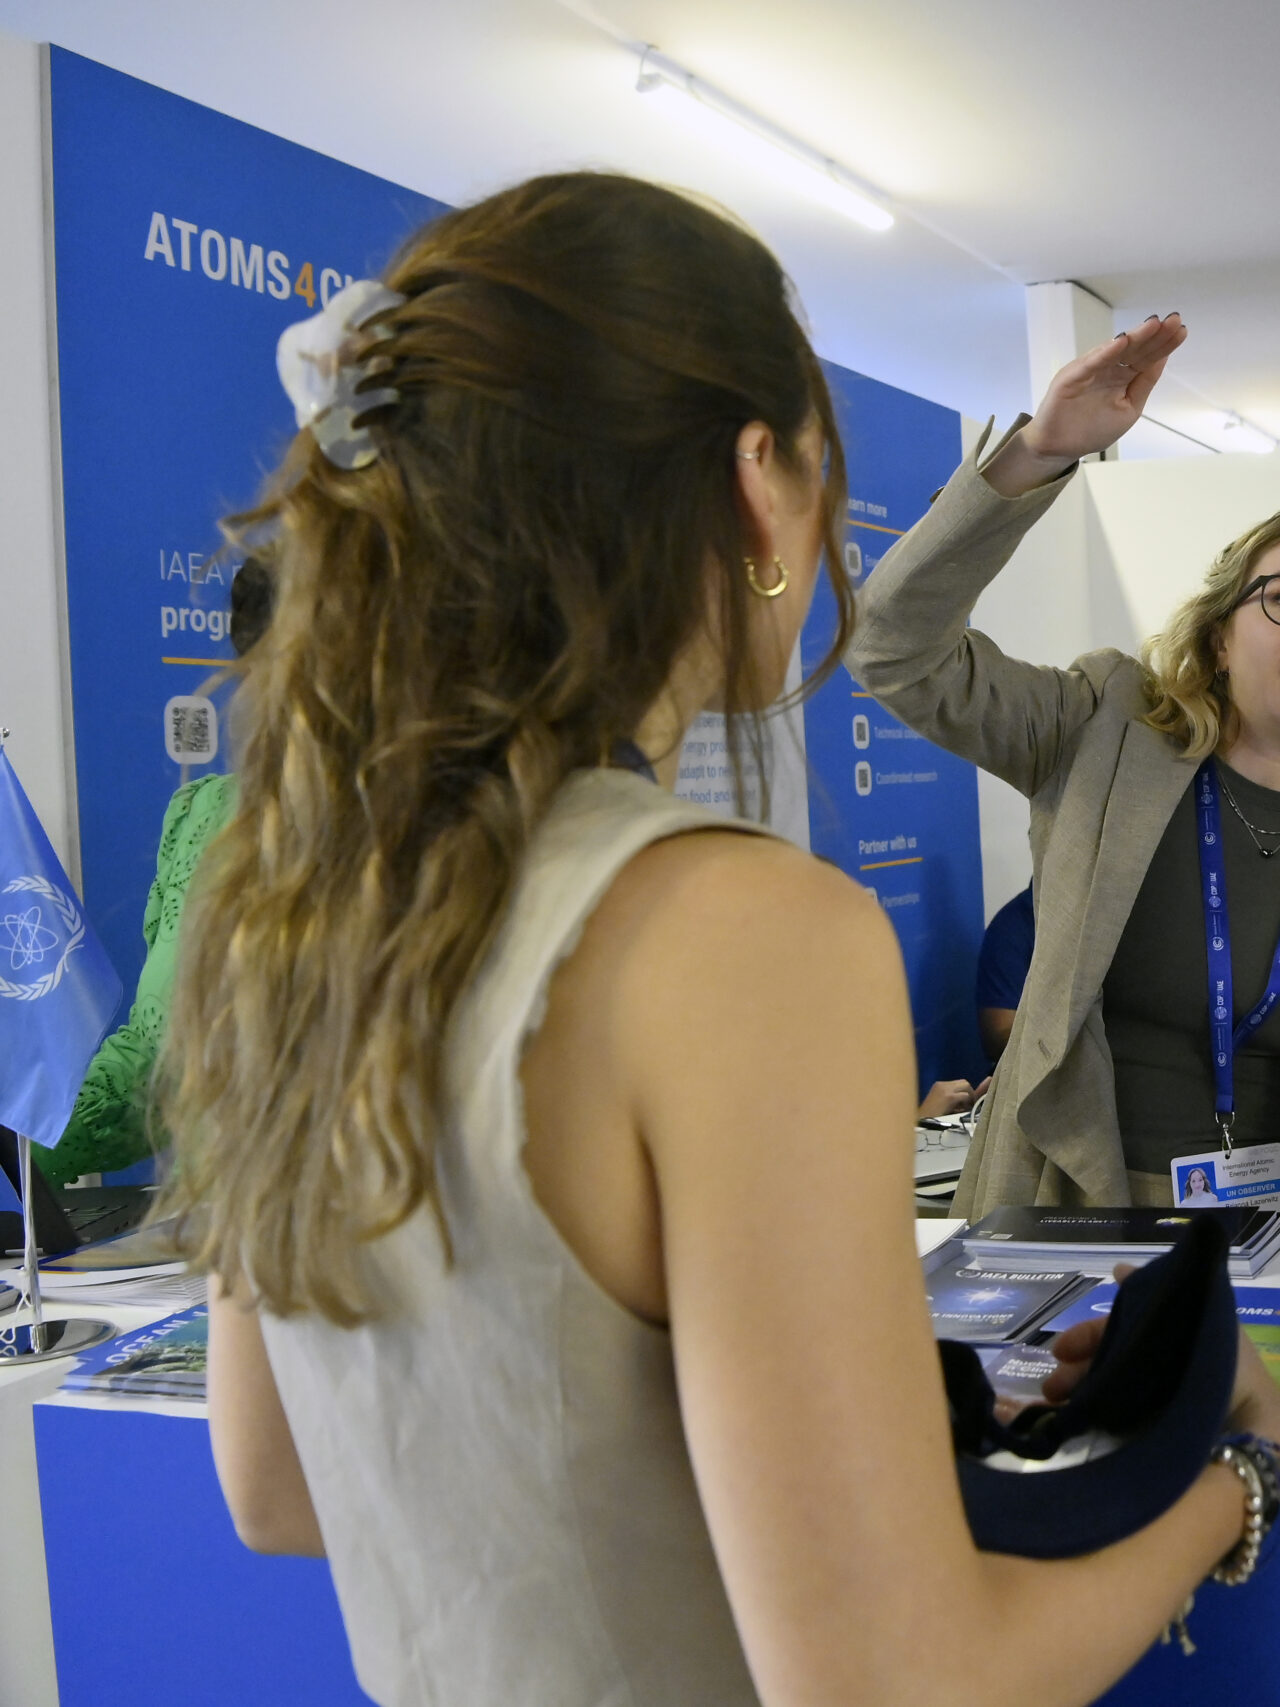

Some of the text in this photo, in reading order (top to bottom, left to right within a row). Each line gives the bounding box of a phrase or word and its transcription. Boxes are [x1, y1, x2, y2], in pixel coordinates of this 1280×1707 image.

[159, 548, 225, 586] IAEA
[690, 788, 712, 803] food
[858, 839, 888, 855] Partner
[1222, 1158, 1275, 1171] International Atomic
[1229, 1166, 1270, 1178] Energy Agency
[1226, 1183, 1276, 1198] UN OBSERVER
[980, 1272, 1065, 1281] IAEA BULLETIN
